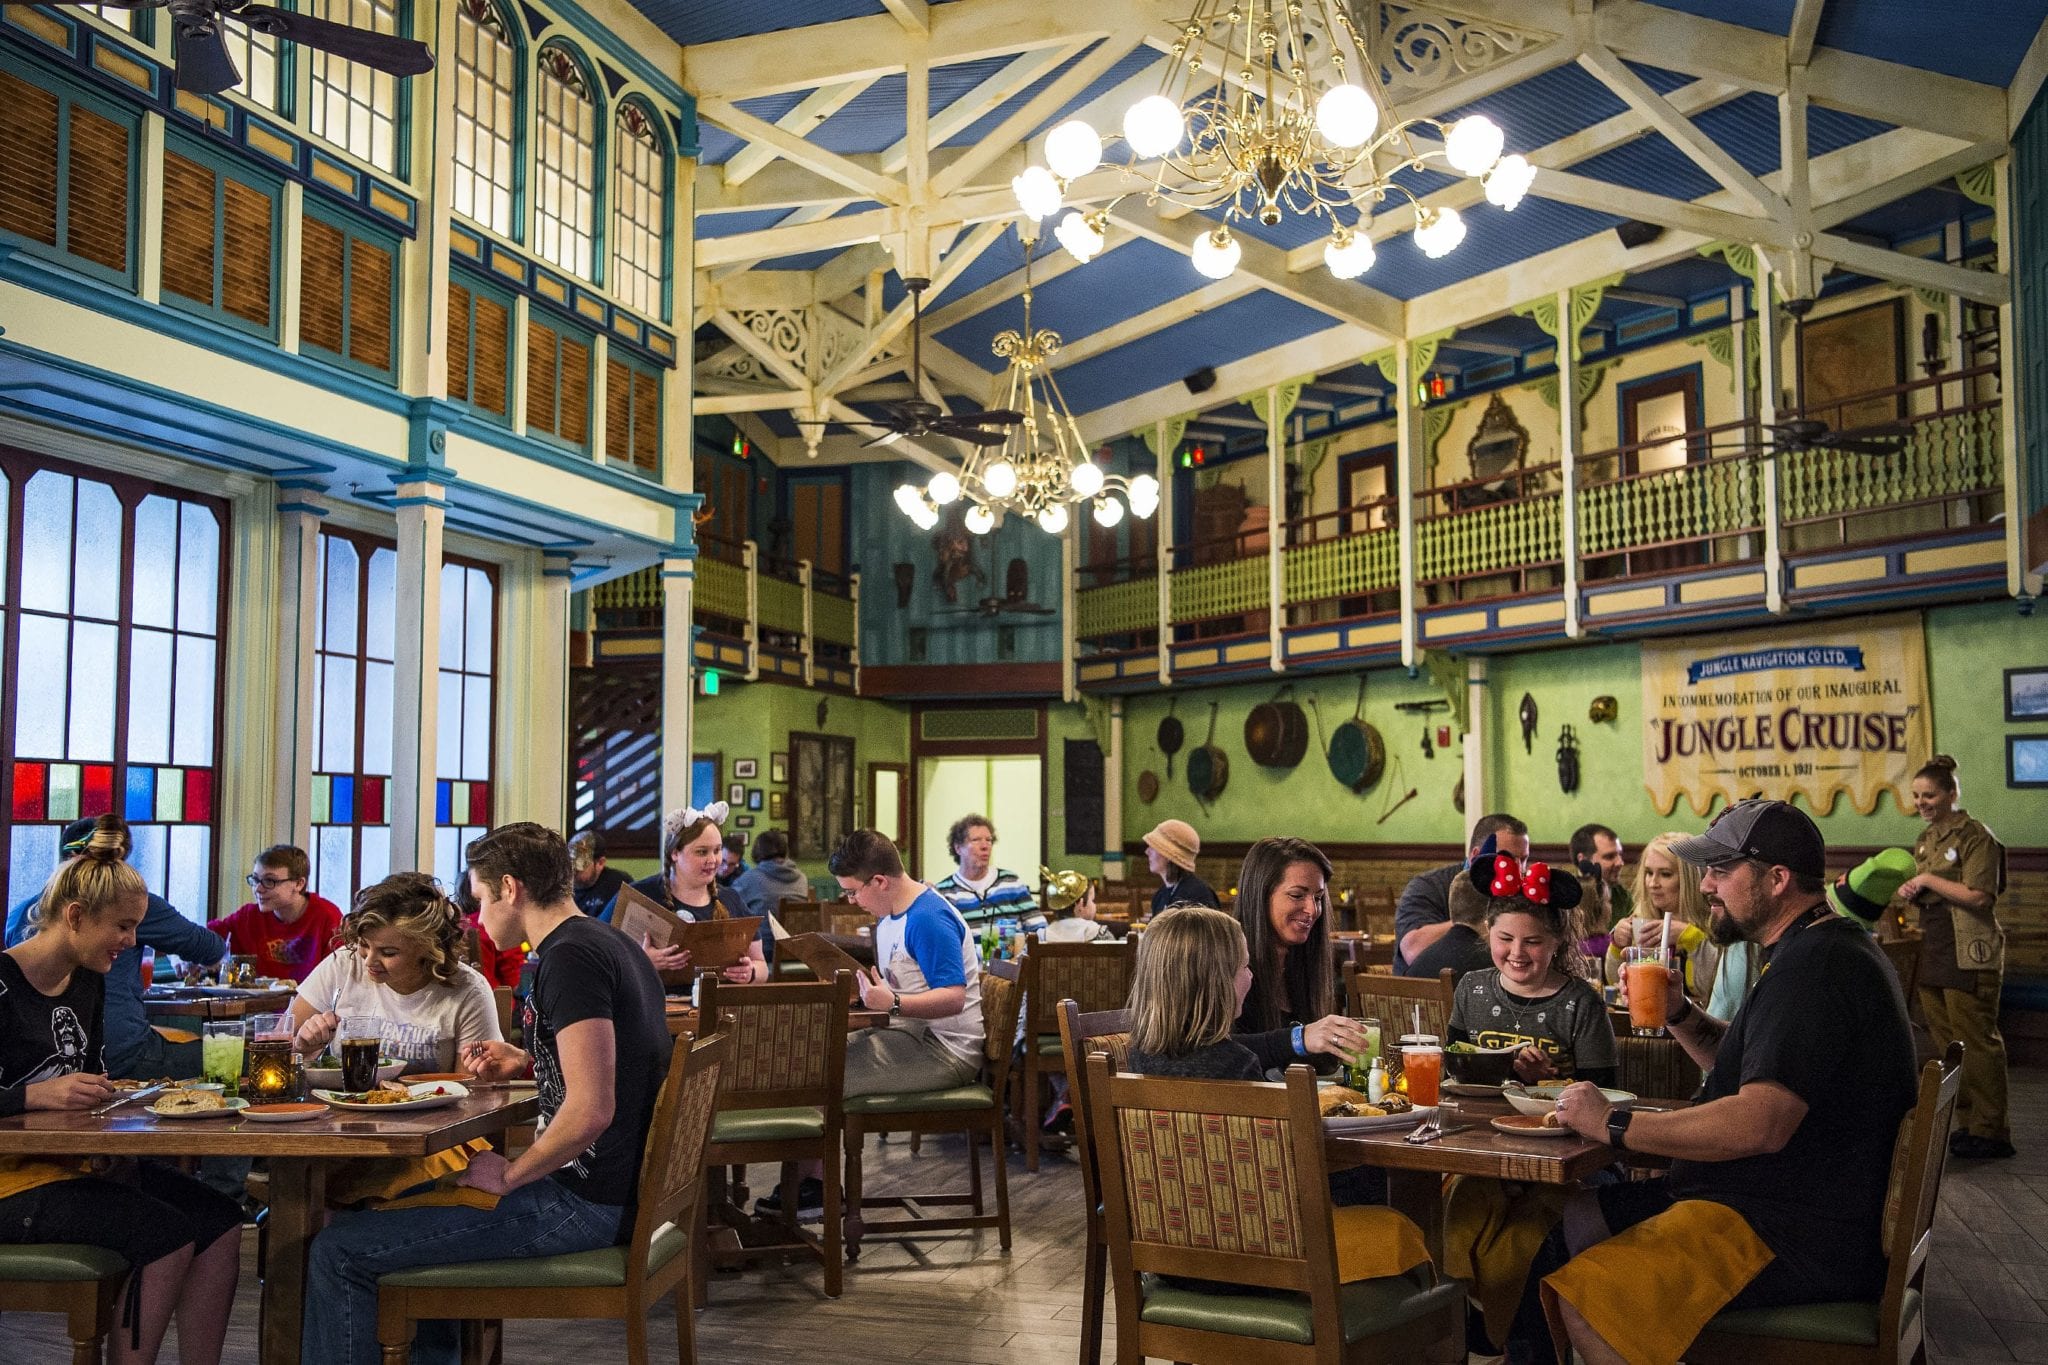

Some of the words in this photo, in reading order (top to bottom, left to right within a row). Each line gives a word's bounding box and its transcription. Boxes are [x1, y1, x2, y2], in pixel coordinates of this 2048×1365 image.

[1700, 659, 1738, 678] JUNGLE
[1741, 651, 1806, 670] NAVIGATION
[1823, 650, 1848, 664] LTD.
[1663, 694, 1676, 708] IN
[1677, 689, 1773, 707] COMMEMORATION
[1776, 687, 1791, 702] OF
[1797, 685, 1821, 700] OUR
[1826, 678, 1902, 698] INAUGURAL
[1738, 765, 1781, 778] OCTOBER
